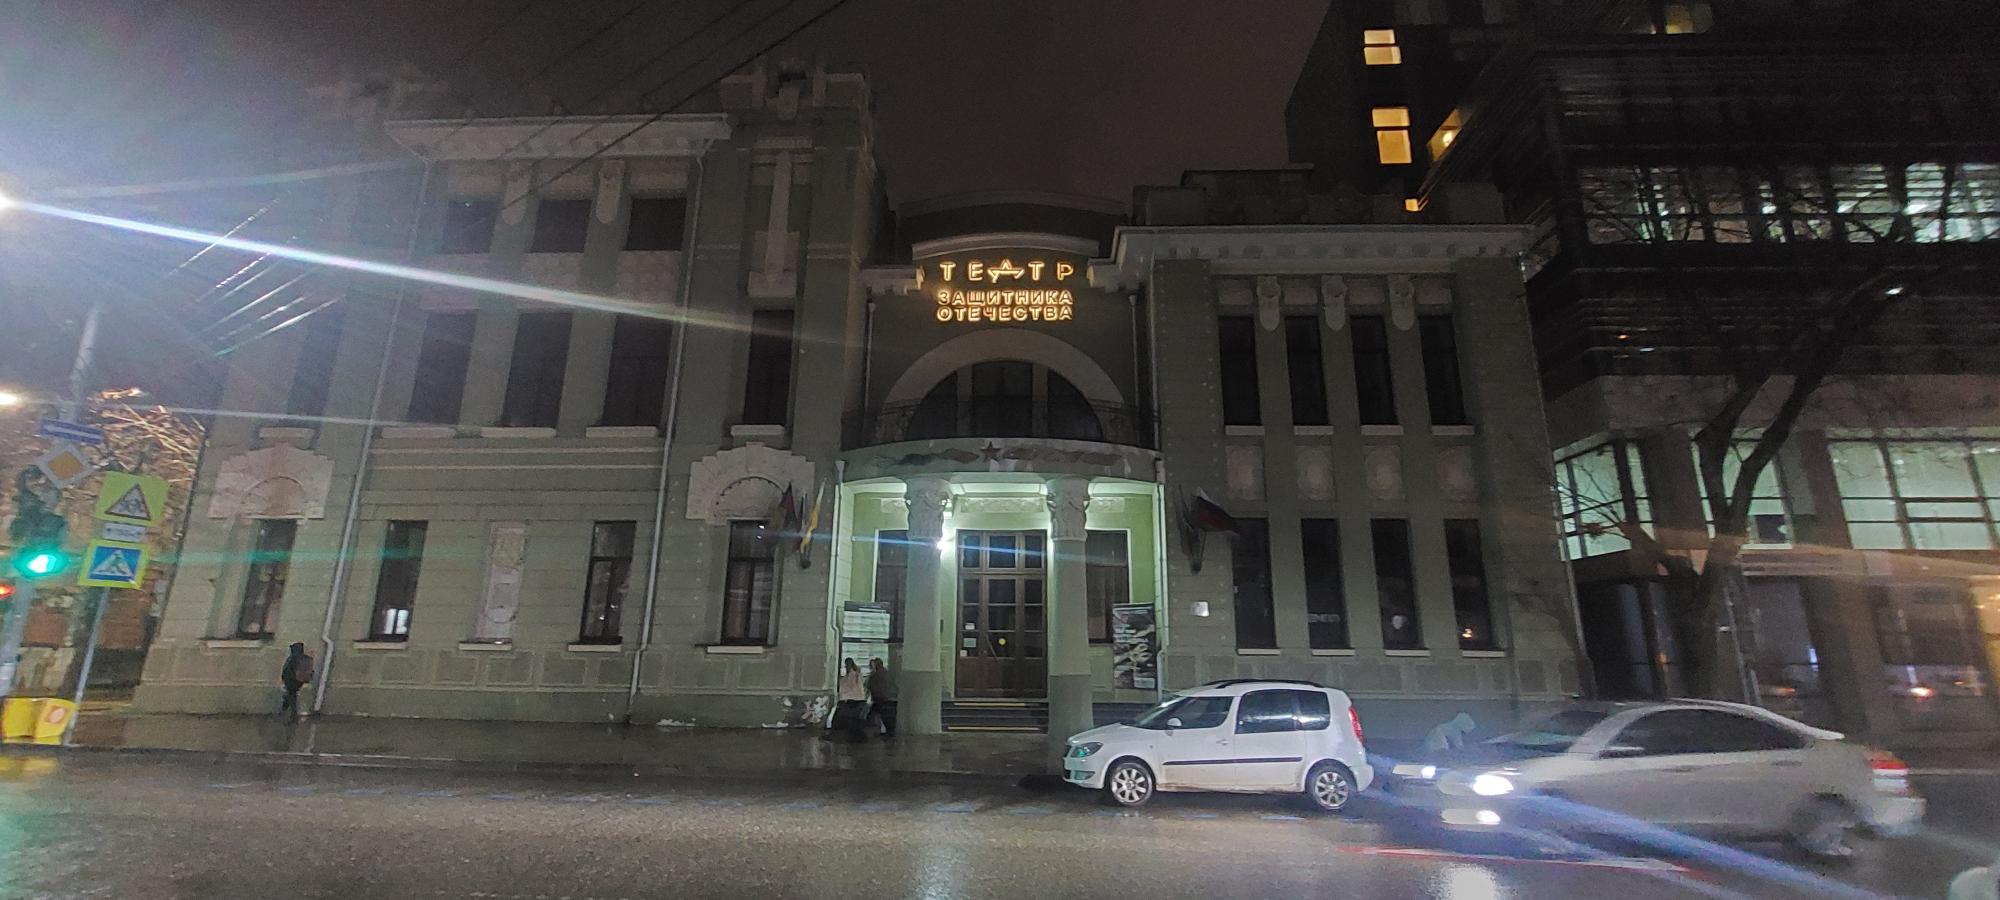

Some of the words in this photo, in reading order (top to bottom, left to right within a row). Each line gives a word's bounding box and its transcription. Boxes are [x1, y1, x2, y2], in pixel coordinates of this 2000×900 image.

[939, 259, 1074, 283] ТЕАТР
[938, 290, 1073, 306] ЗАЩИТНИКА
[936, 305, 1073, 322] ОТЕЧЕСТВА
